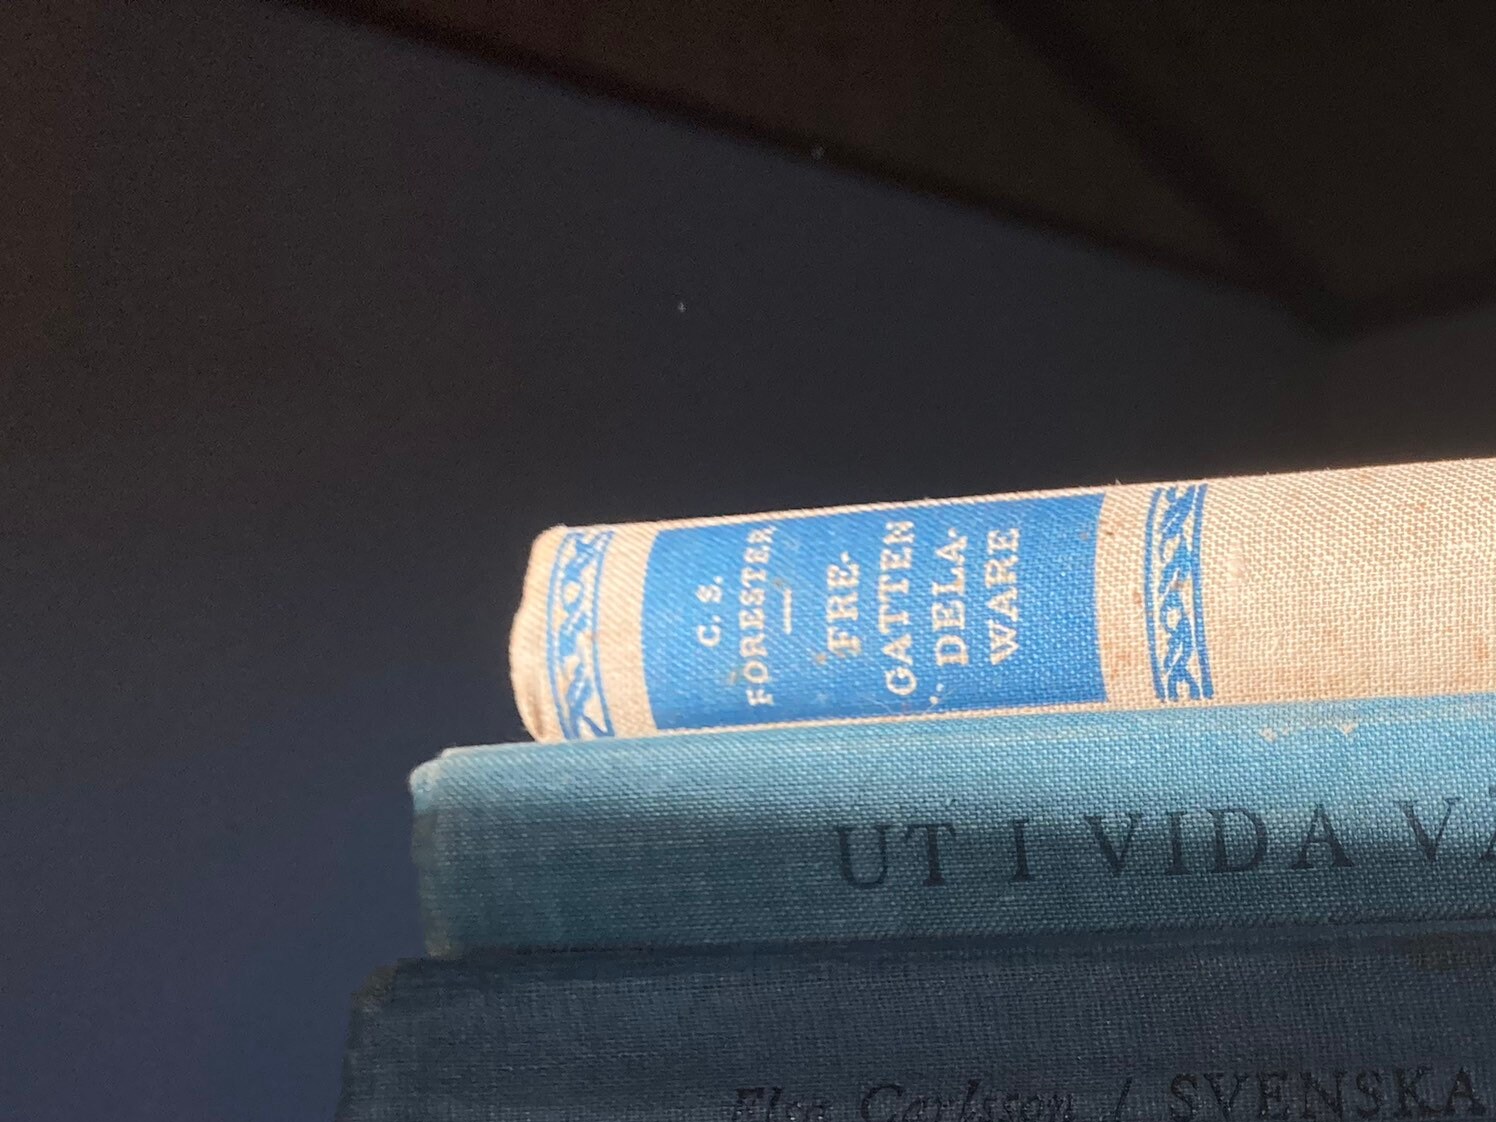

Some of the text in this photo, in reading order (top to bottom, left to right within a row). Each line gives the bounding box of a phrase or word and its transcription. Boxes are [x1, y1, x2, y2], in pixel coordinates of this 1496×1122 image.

[738, 525, 777, 706] FORESTER
[877, 520, 917, 696] GATTEN
[984, 527, 1020, 666] WARE
[836, 822, 957, 887] UT
[1009, 818, 1031, 883] I
[1084, 803, 1354, 875] VIDA
